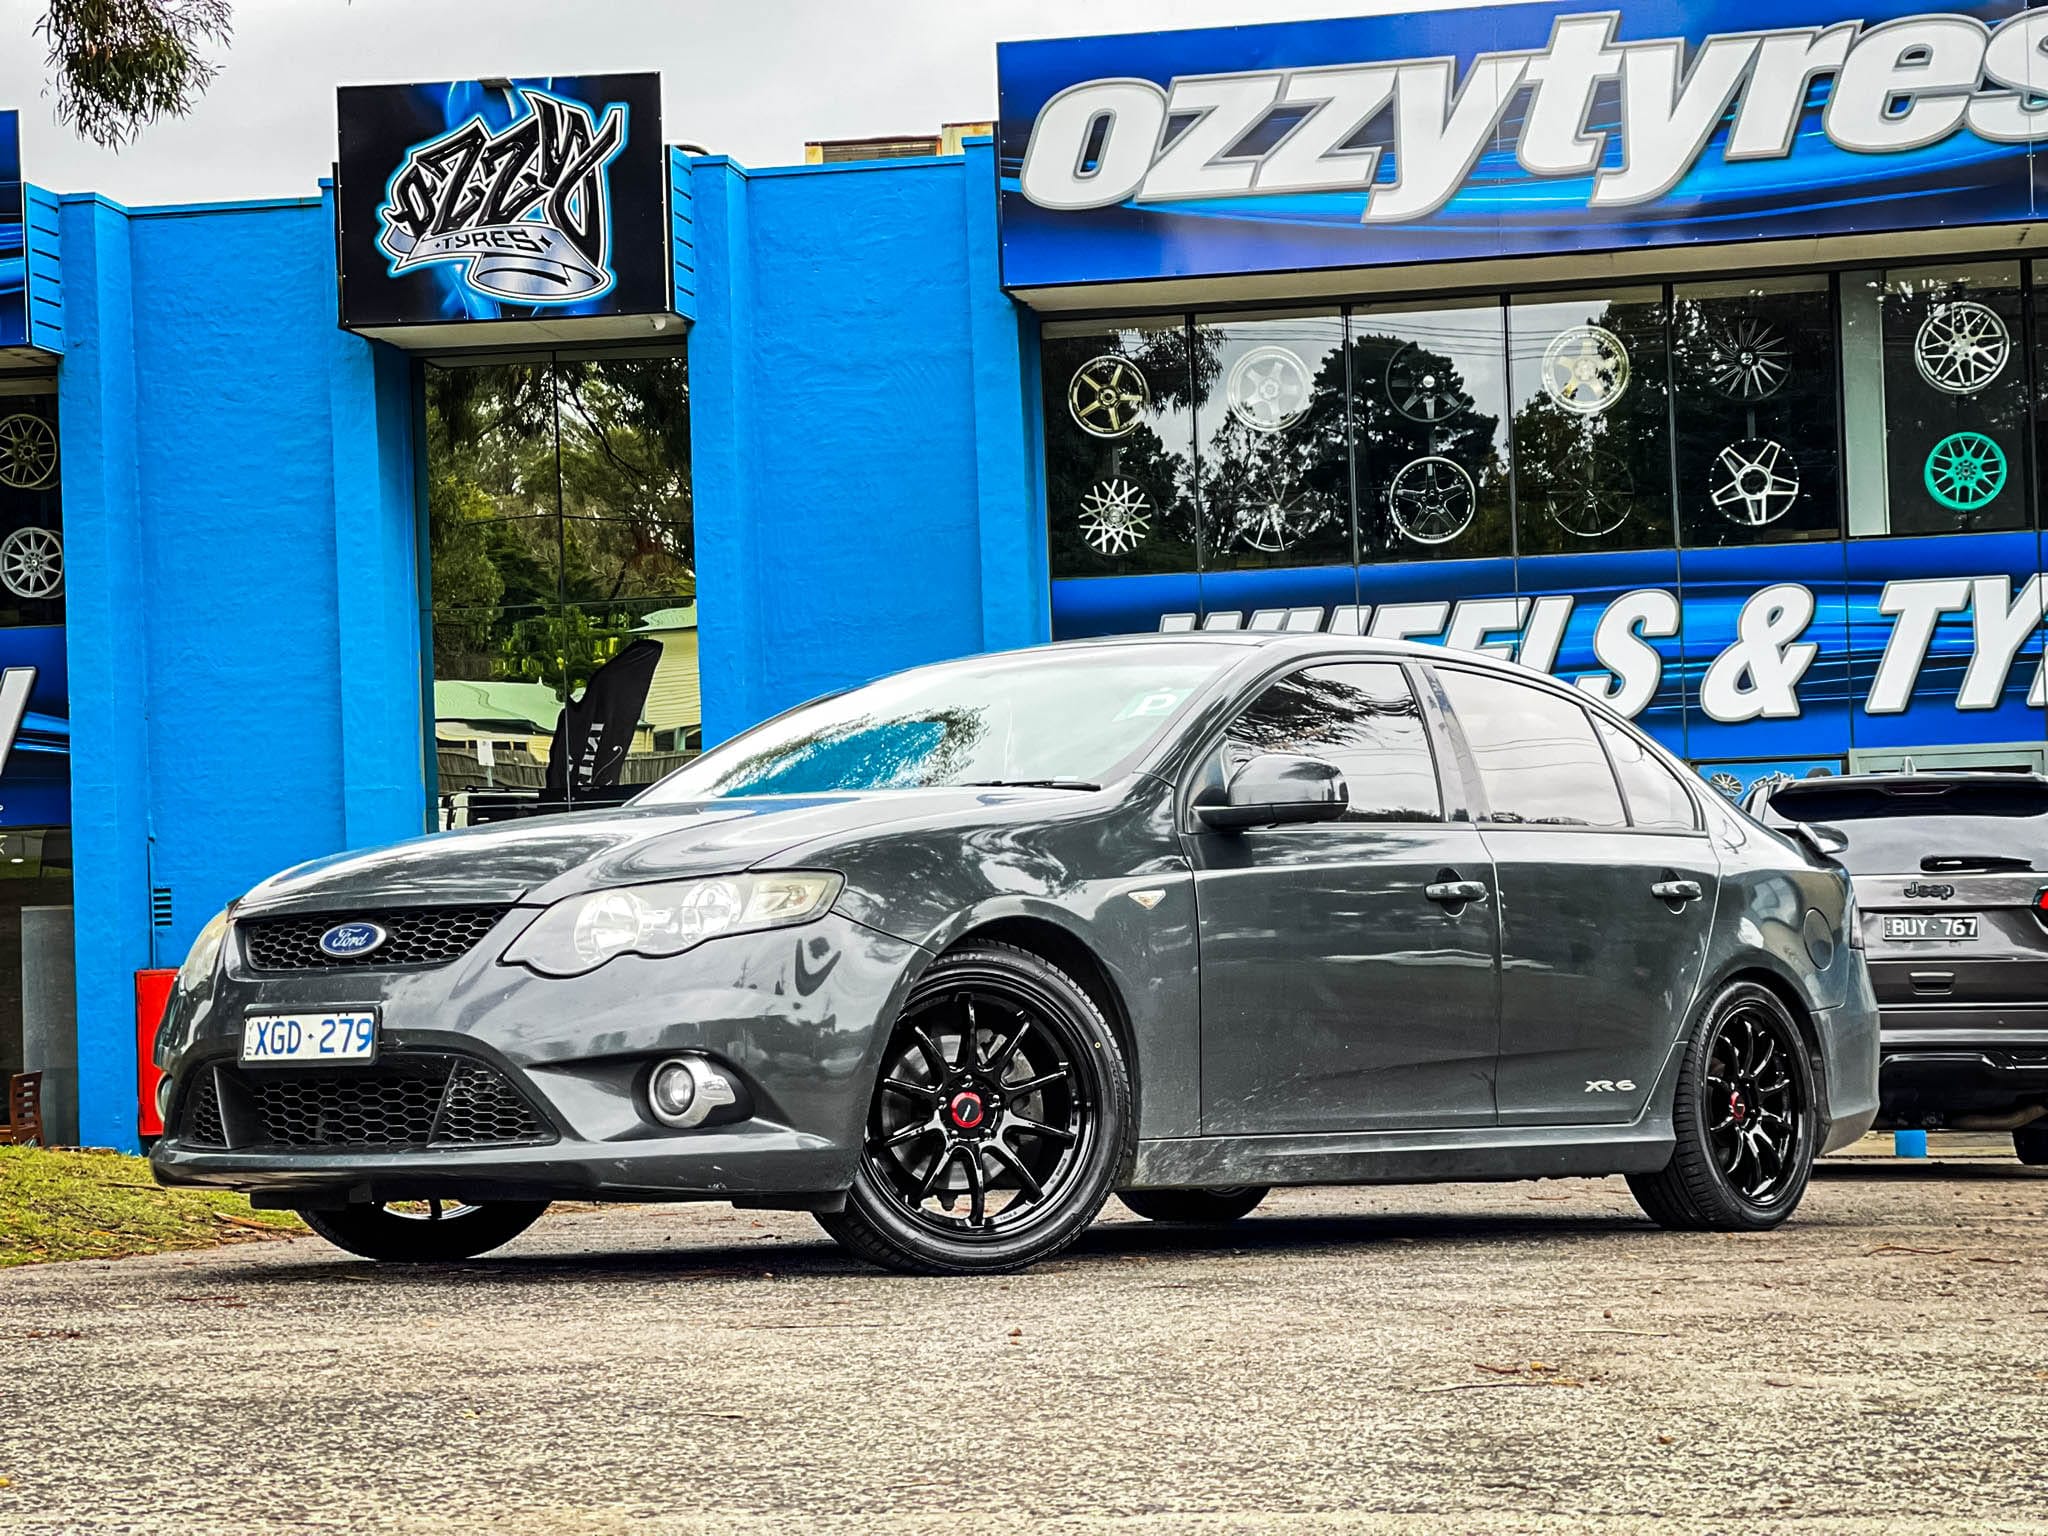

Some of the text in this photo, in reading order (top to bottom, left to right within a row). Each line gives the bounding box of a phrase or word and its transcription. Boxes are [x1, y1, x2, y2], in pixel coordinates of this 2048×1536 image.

[442, 229, 545, 254] TYRES
[1700, 582, 1817, 722] &
[1865, 574, 2048, 714] TY
[1904, 882, 1955, 900] Jeep
[331, 927, 370, 948] Ford
[1892, 919, 1928, 936] BUY
[1939, 919, 1977, 936] 767
[255, 1020, 301, 1055] XGD
[319, 1018, 373, 1053] 279
[1584, 1080, 1637, 1092] XR6
